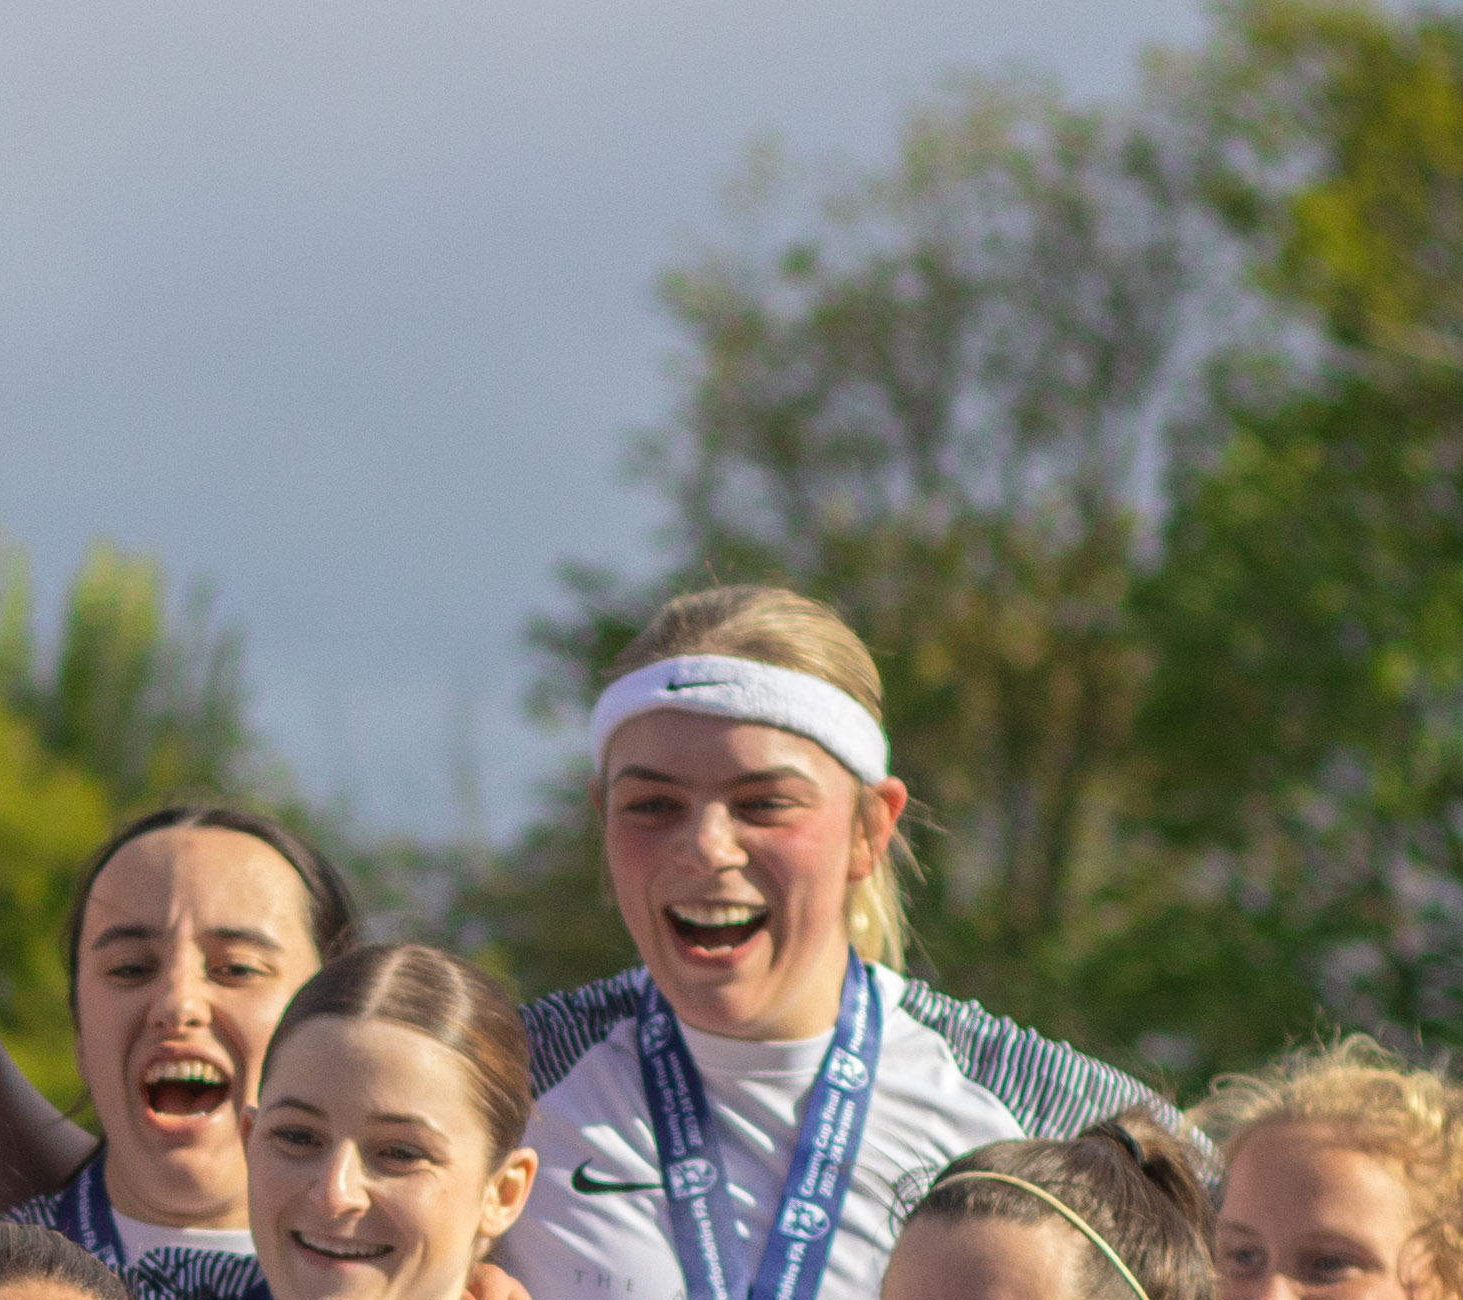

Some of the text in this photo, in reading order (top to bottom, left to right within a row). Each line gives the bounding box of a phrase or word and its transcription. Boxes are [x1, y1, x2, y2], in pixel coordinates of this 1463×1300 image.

[834, 1100, 855, 1144] Season
[798, 1088, 841, 1197] County Cup Final
[690, 1197, 708, 1219] FA
[787, 1242, 807, 1264] FA
